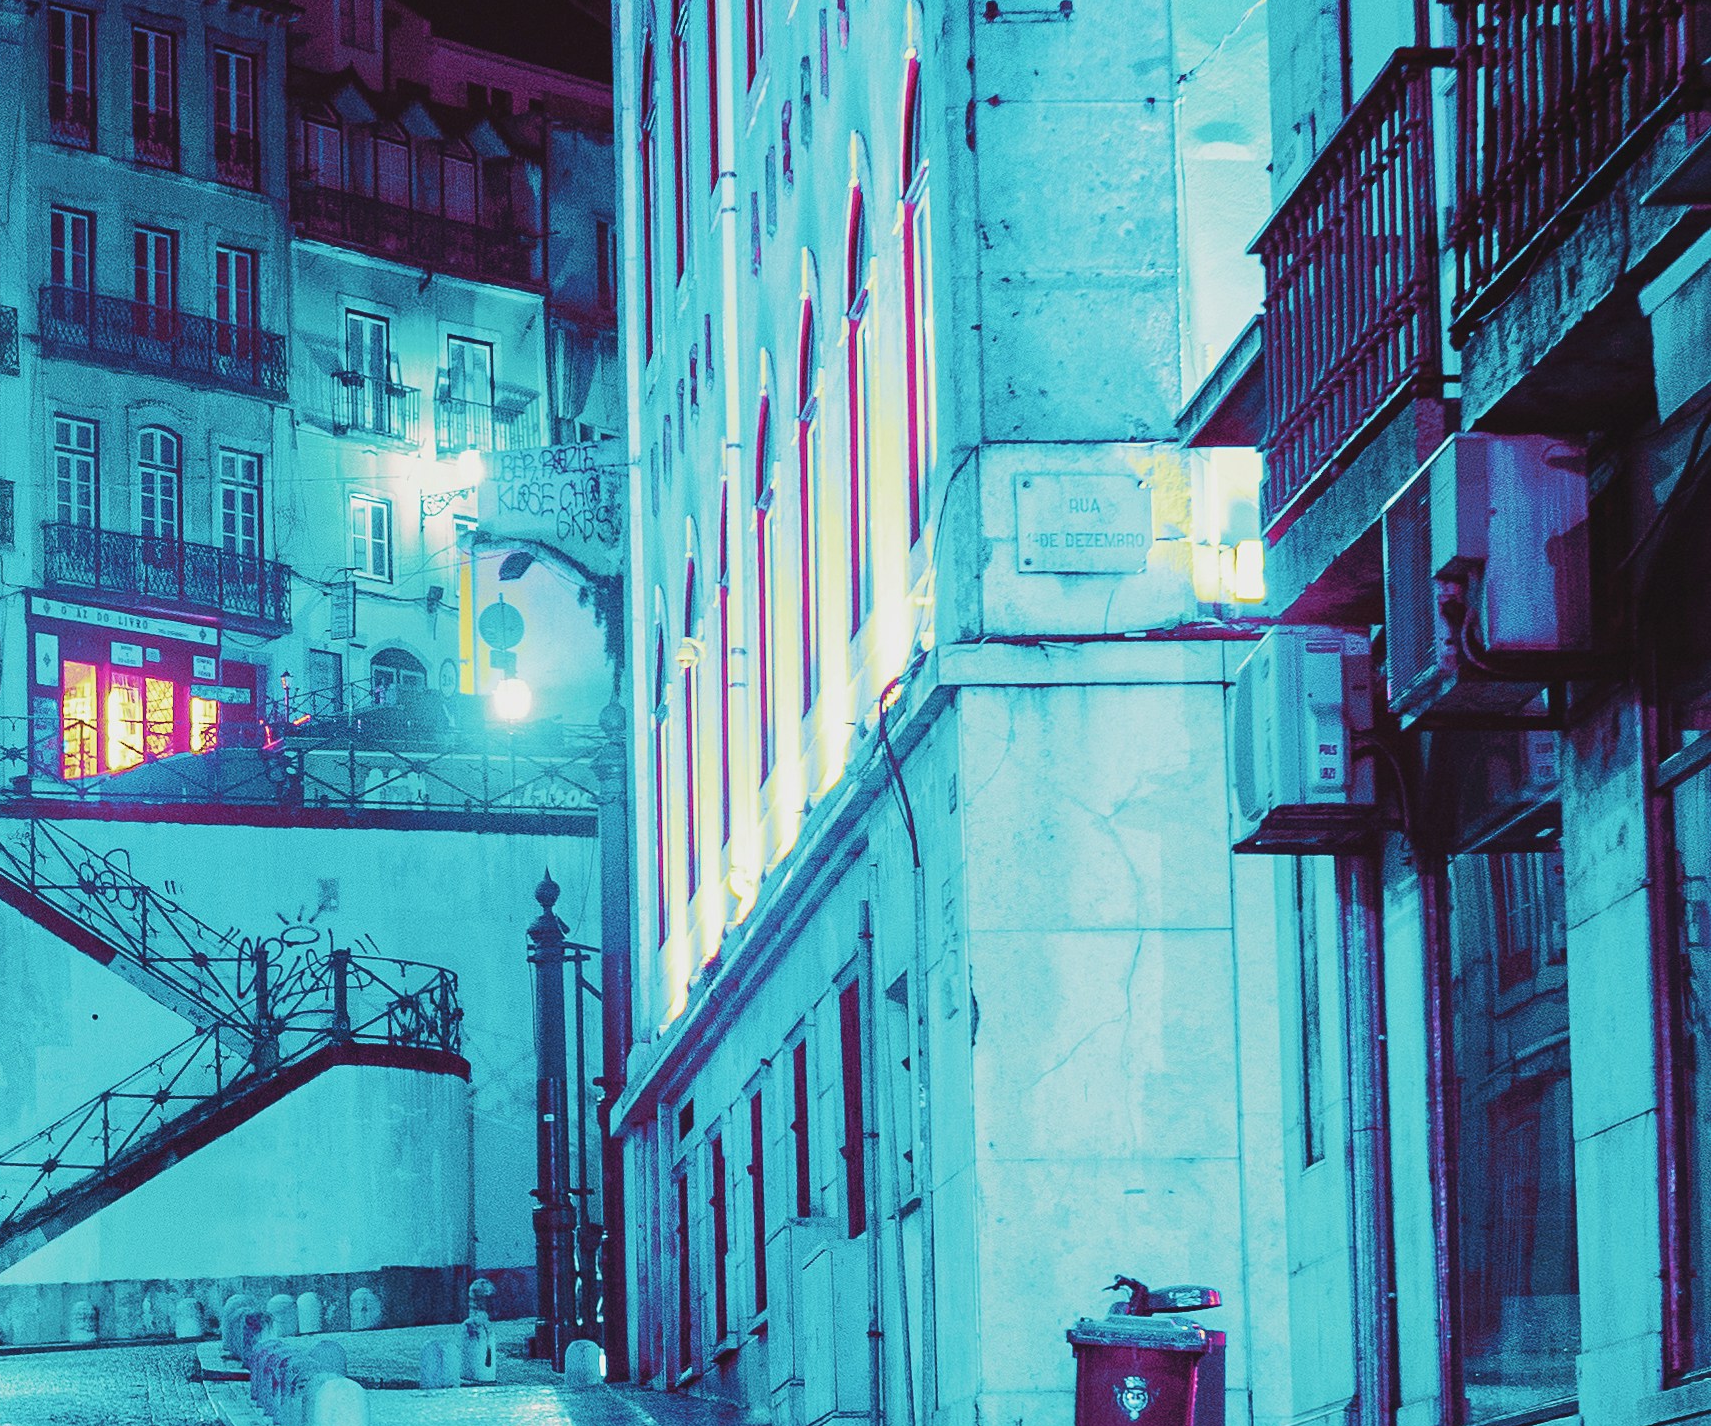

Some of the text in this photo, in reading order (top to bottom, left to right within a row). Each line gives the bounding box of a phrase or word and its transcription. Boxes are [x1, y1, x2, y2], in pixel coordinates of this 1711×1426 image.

[1069, 498, 1101, 513] RUA
[1039, 533, 1059, 548] DE
[1065, 533, 1145, 548] DEZEMBRO
[97, 611, 110, 623] DO
[118, 615, 149, 630] LIVRO
